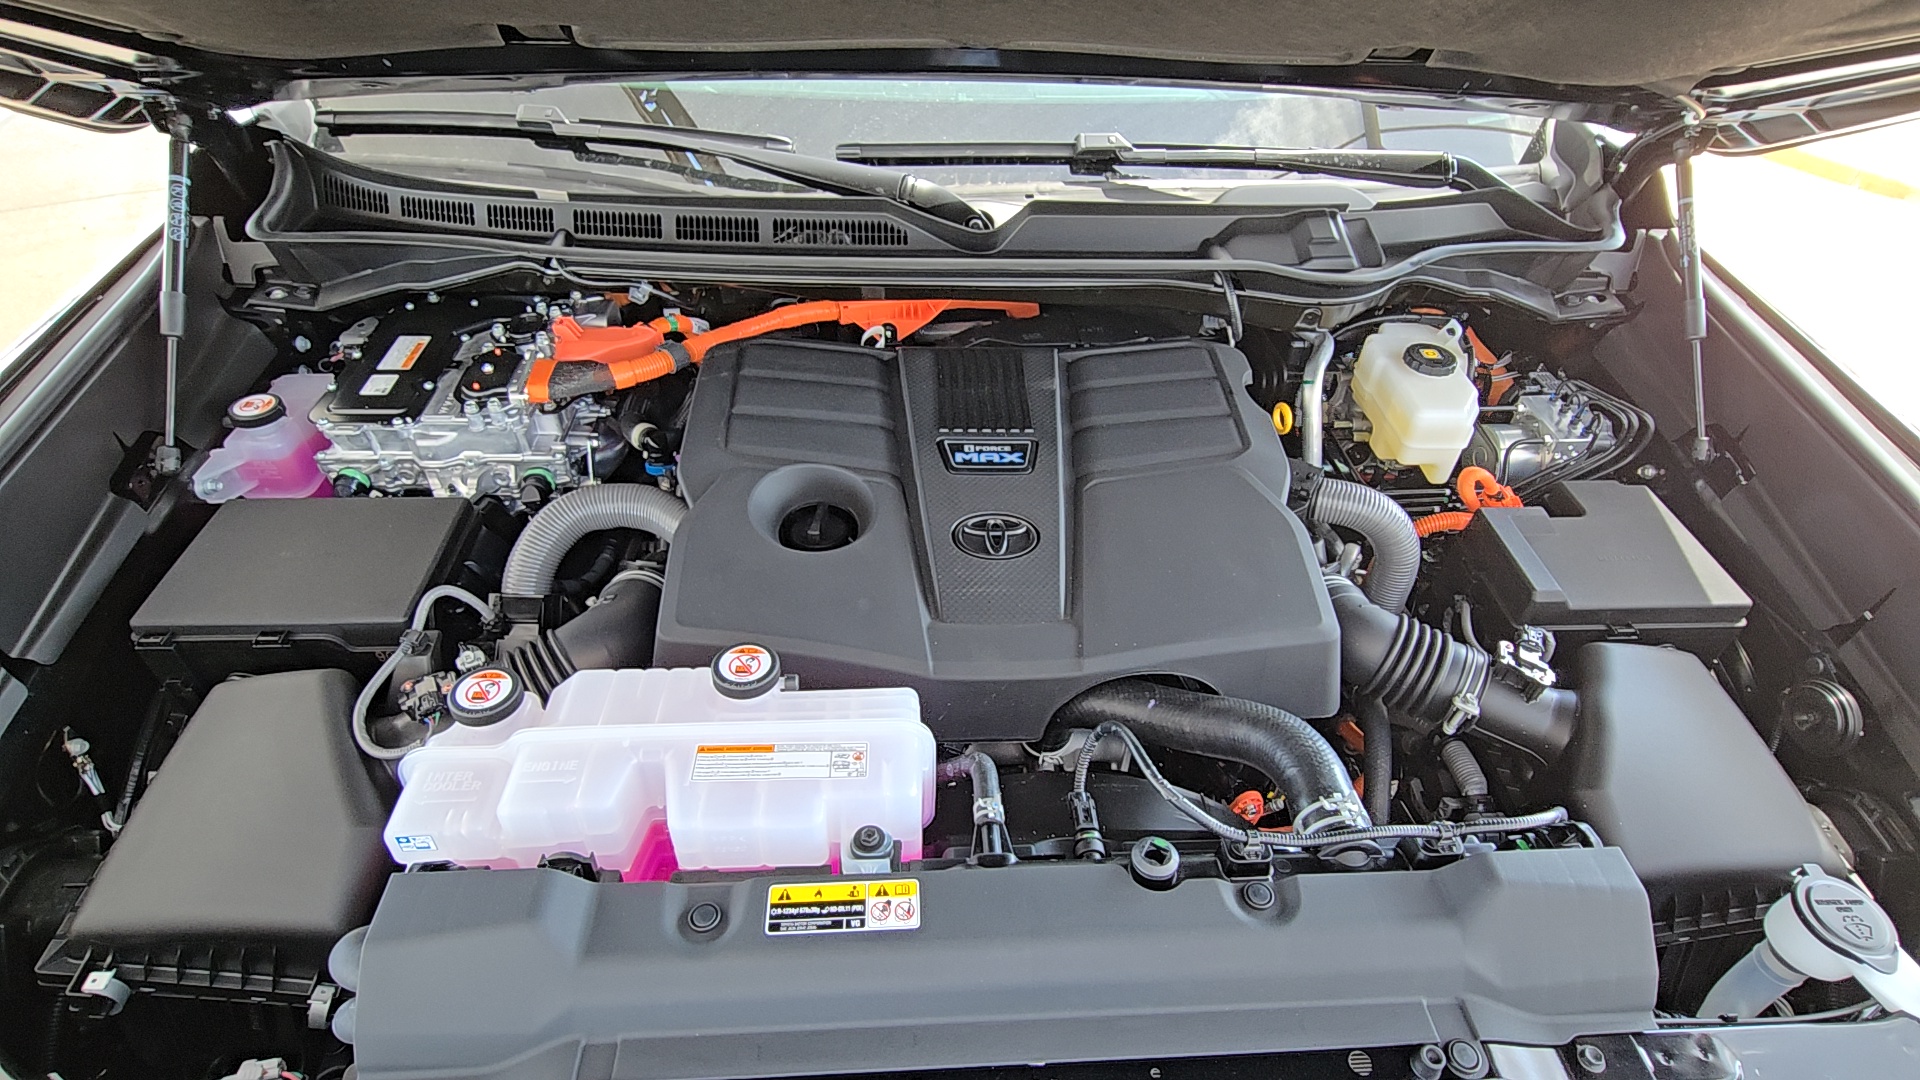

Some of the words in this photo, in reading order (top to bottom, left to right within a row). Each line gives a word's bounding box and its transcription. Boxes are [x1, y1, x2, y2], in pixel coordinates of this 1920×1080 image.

[954, 452, 1024, 463] MAX
[427, 771, 474, 782] INTER
[423, 780, 482, 791] COOLER
